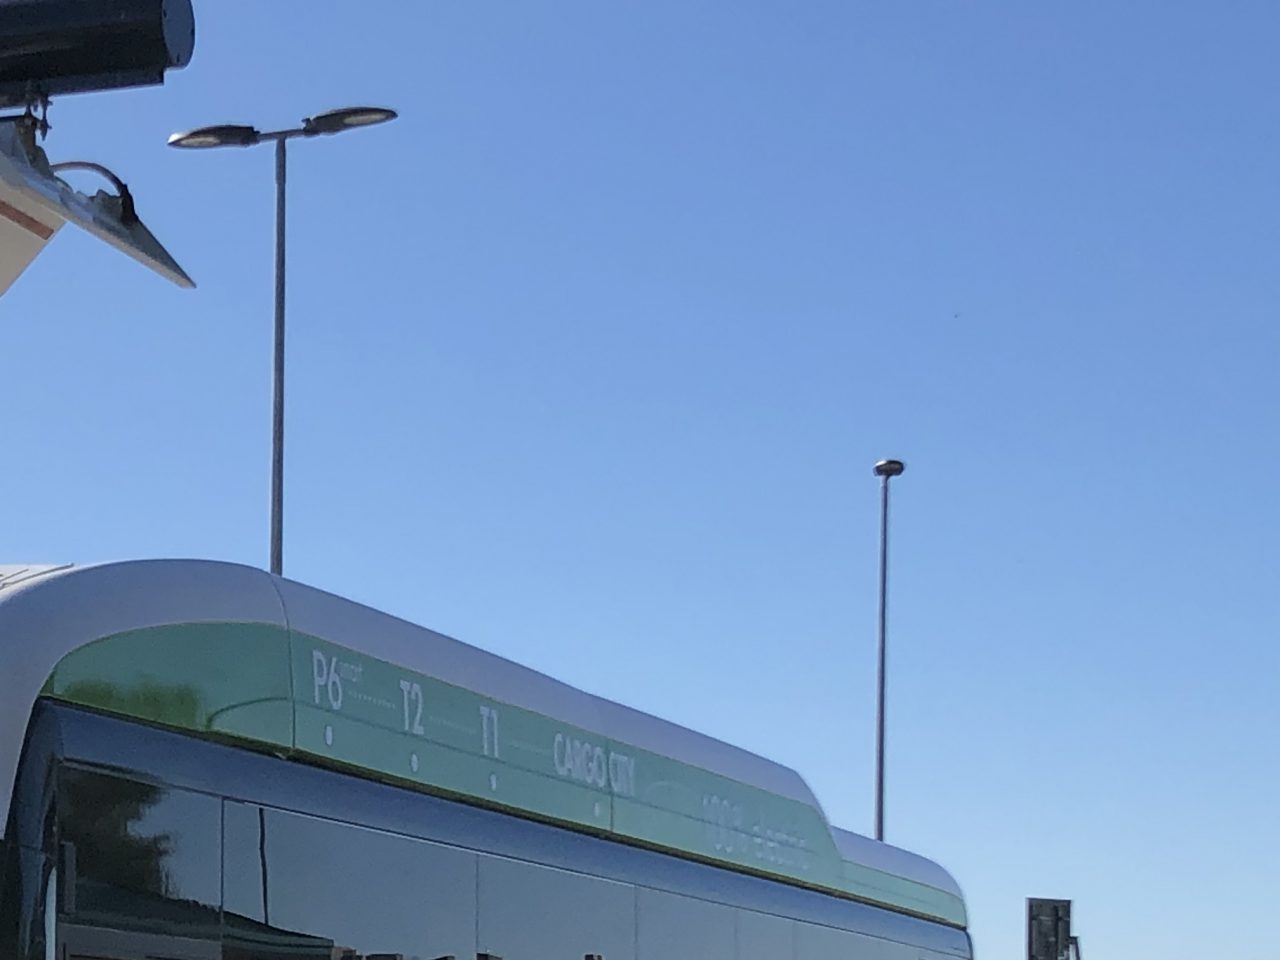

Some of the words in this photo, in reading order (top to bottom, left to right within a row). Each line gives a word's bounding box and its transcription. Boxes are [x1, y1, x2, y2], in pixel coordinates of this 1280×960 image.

[312, 650, 343, 711] P6
[400, 679, 424, 735] T2
[479, 706, 499, 758] T1
[553, 732, 606, 788] CARGO
